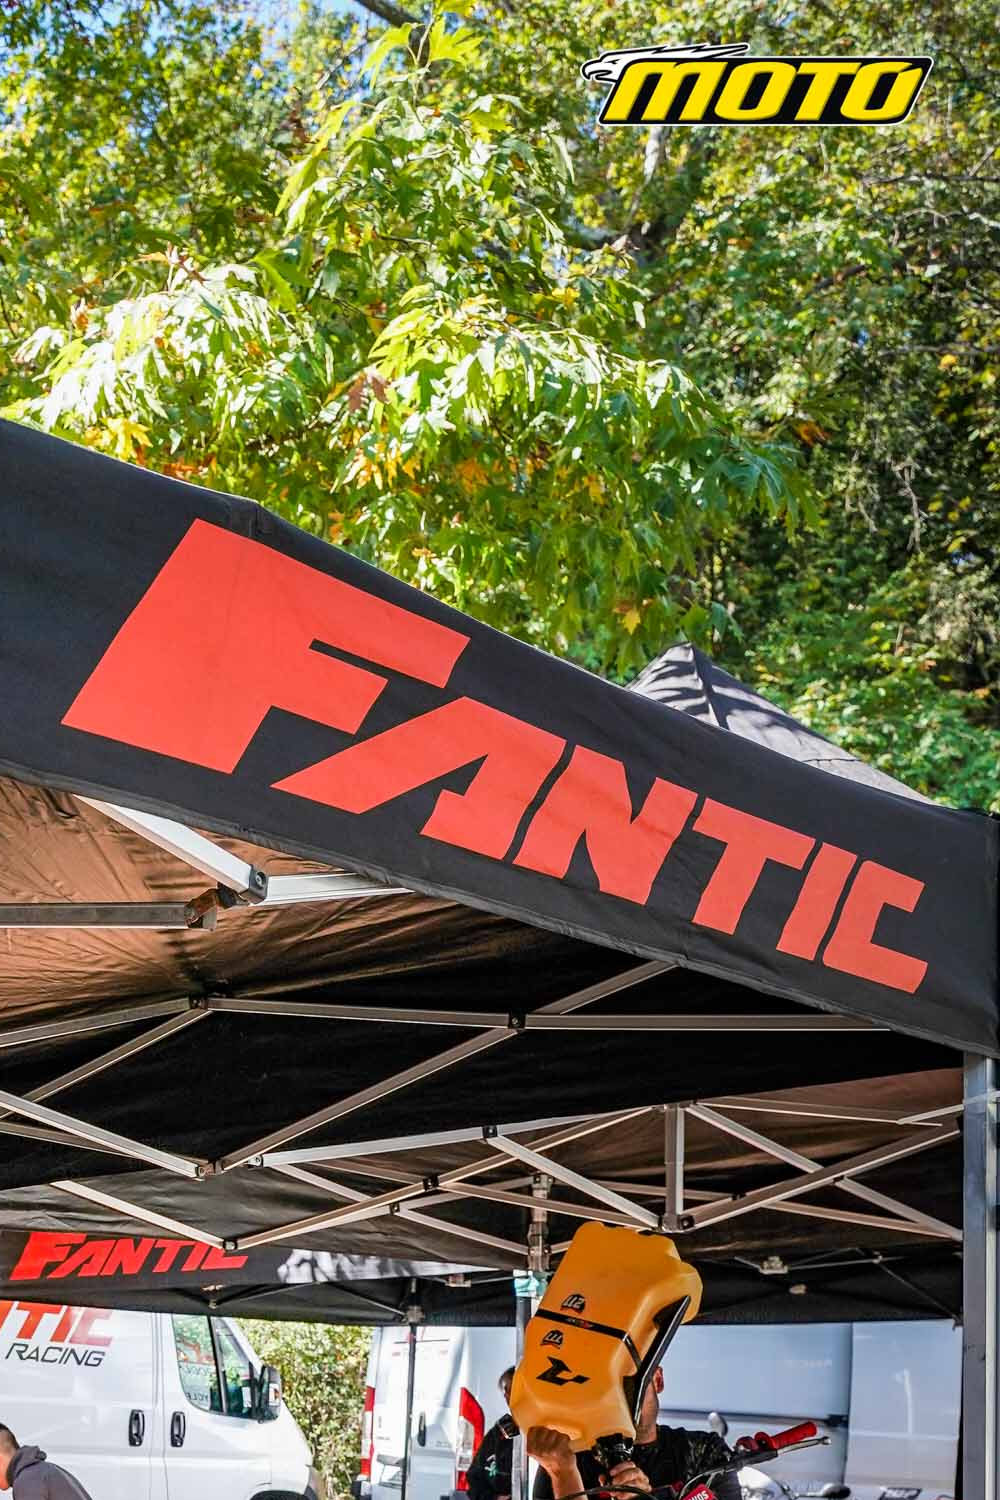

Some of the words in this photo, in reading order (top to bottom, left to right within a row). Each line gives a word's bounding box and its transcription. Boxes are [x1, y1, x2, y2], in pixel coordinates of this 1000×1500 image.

[61, 518, 928, 993] FANTIC
[9, 1231, 249, 1280] FANTIC
[5, 1343, 106, 1367] RACING
